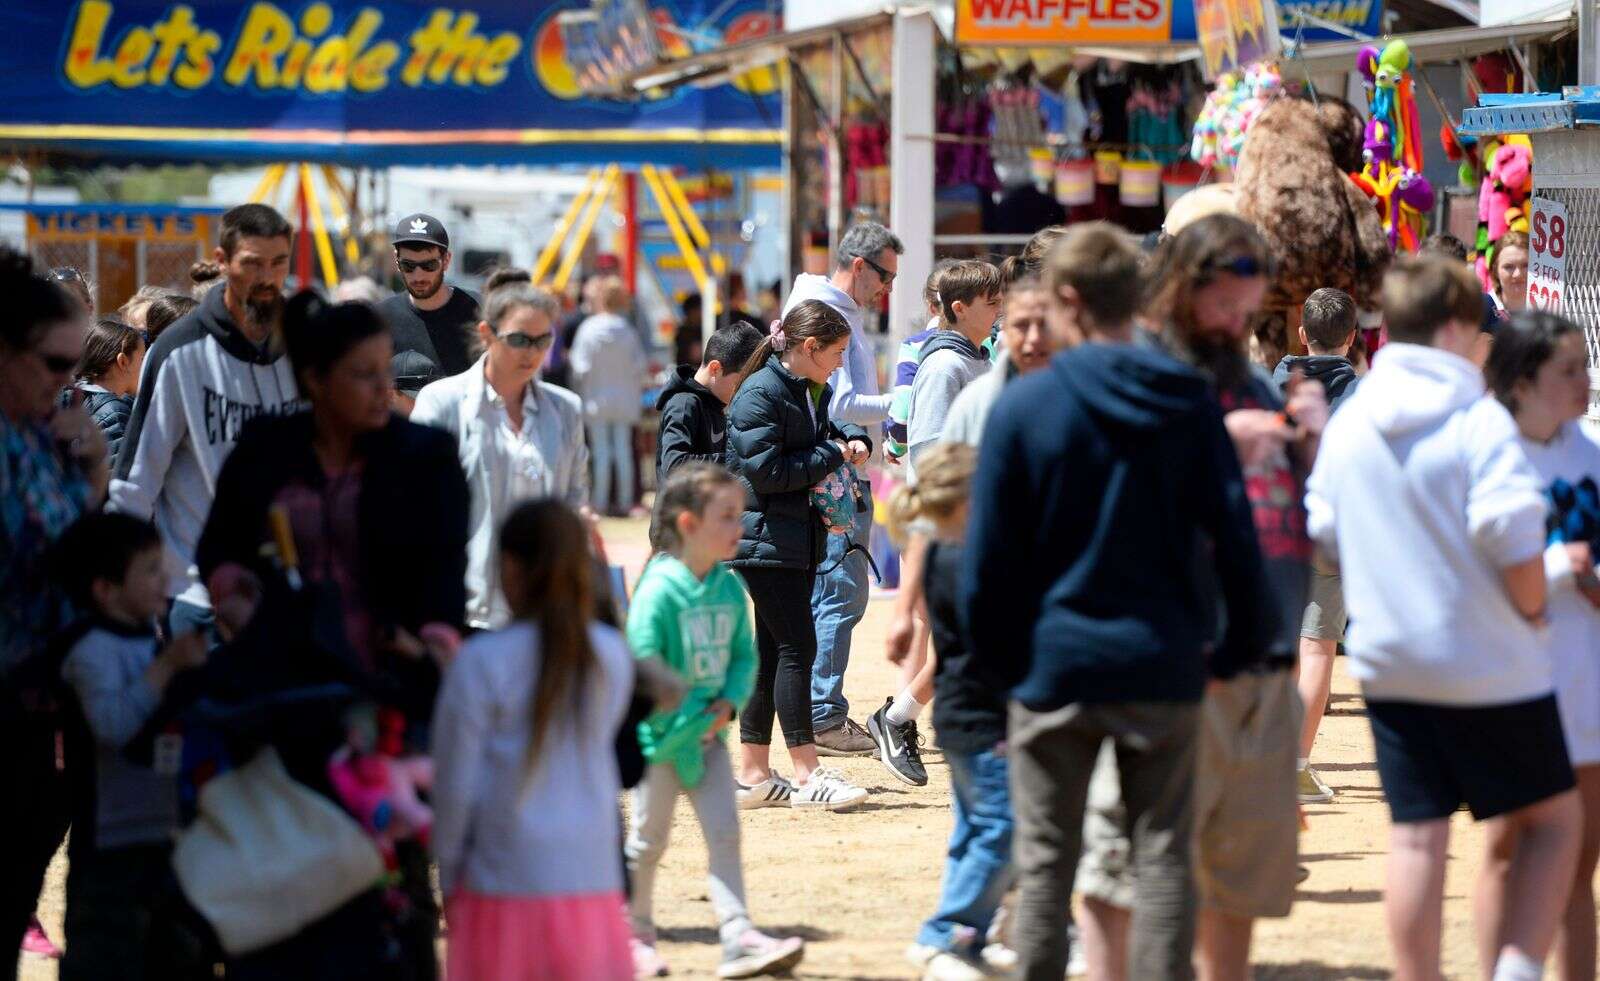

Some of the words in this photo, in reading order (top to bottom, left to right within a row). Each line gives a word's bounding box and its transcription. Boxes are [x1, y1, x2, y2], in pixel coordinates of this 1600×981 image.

[970, 0, 1163, 24] WAFFLES
[65, 0, 221, 89] Lets
[223, 2, 400, 92] Ride
[402, 8, 521, 86] the
[34, 211, 195, 233] TICKETS
[1532, 208, 1565, 258] $8
[1533, 262, 1540, 278] 3
[1543, 264, 1560, 284] FOR
